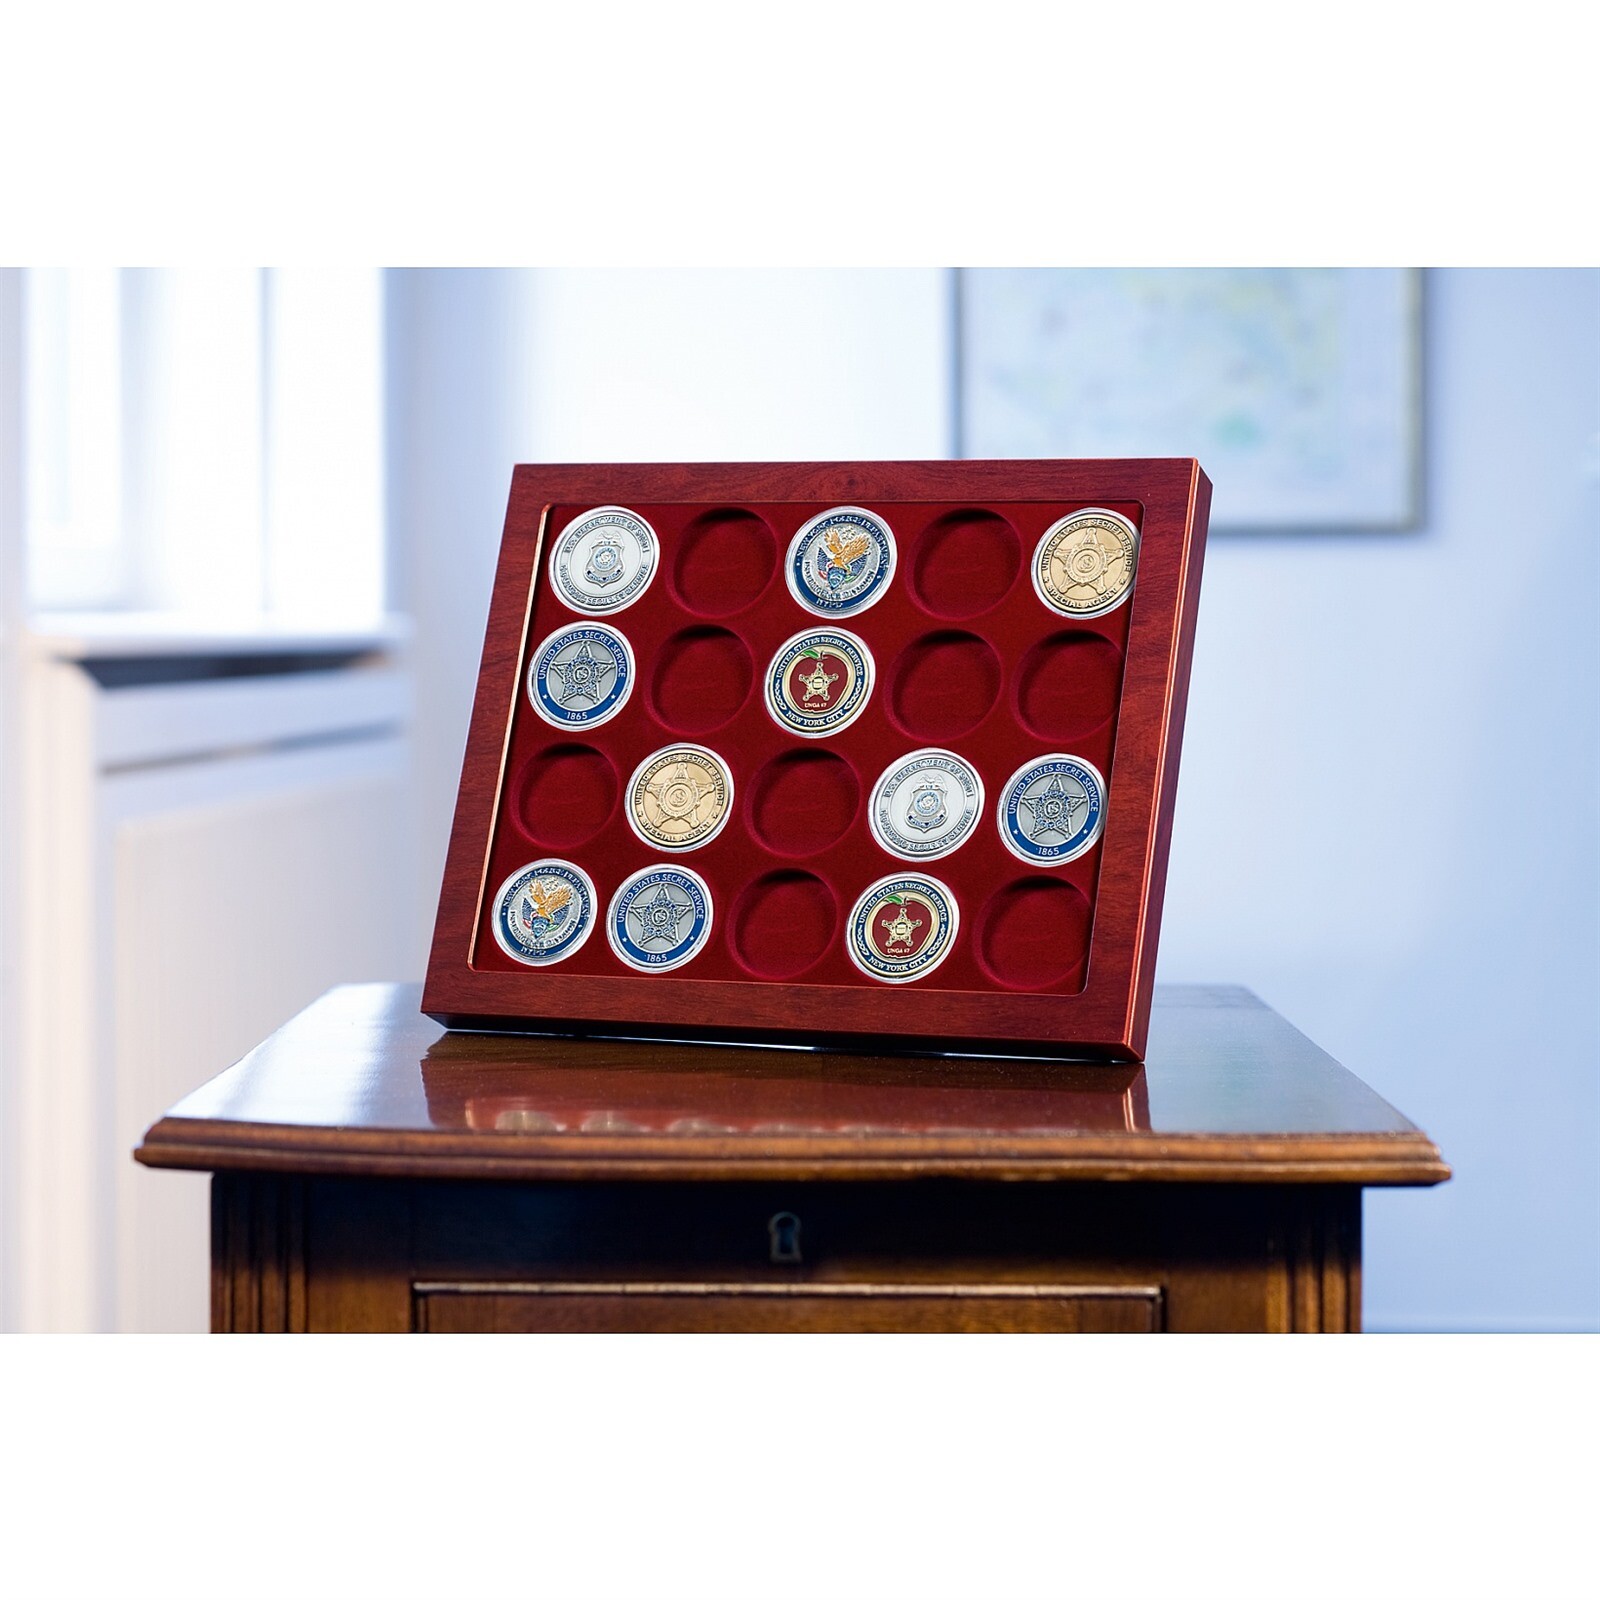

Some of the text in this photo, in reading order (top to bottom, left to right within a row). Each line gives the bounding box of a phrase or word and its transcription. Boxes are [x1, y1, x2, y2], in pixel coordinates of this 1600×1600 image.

[539, 631, 626, 679] UNITED STATES SECRET SERVICE
[567, 712, 587, 720] 1865
[786, 711, 802, 724] NEW
[826, 710, 844, 723] CITY
[1009, 764, 1098, 814] UNITED STATES SECRET SERVICE
[1038, 847, 1059, 855] 1865
[618, 874, 704, 922] UNITED STATES SECRET SERVICE
[869, 957, 885, 969] NEW
[909, 956, 927, 969] CITY
